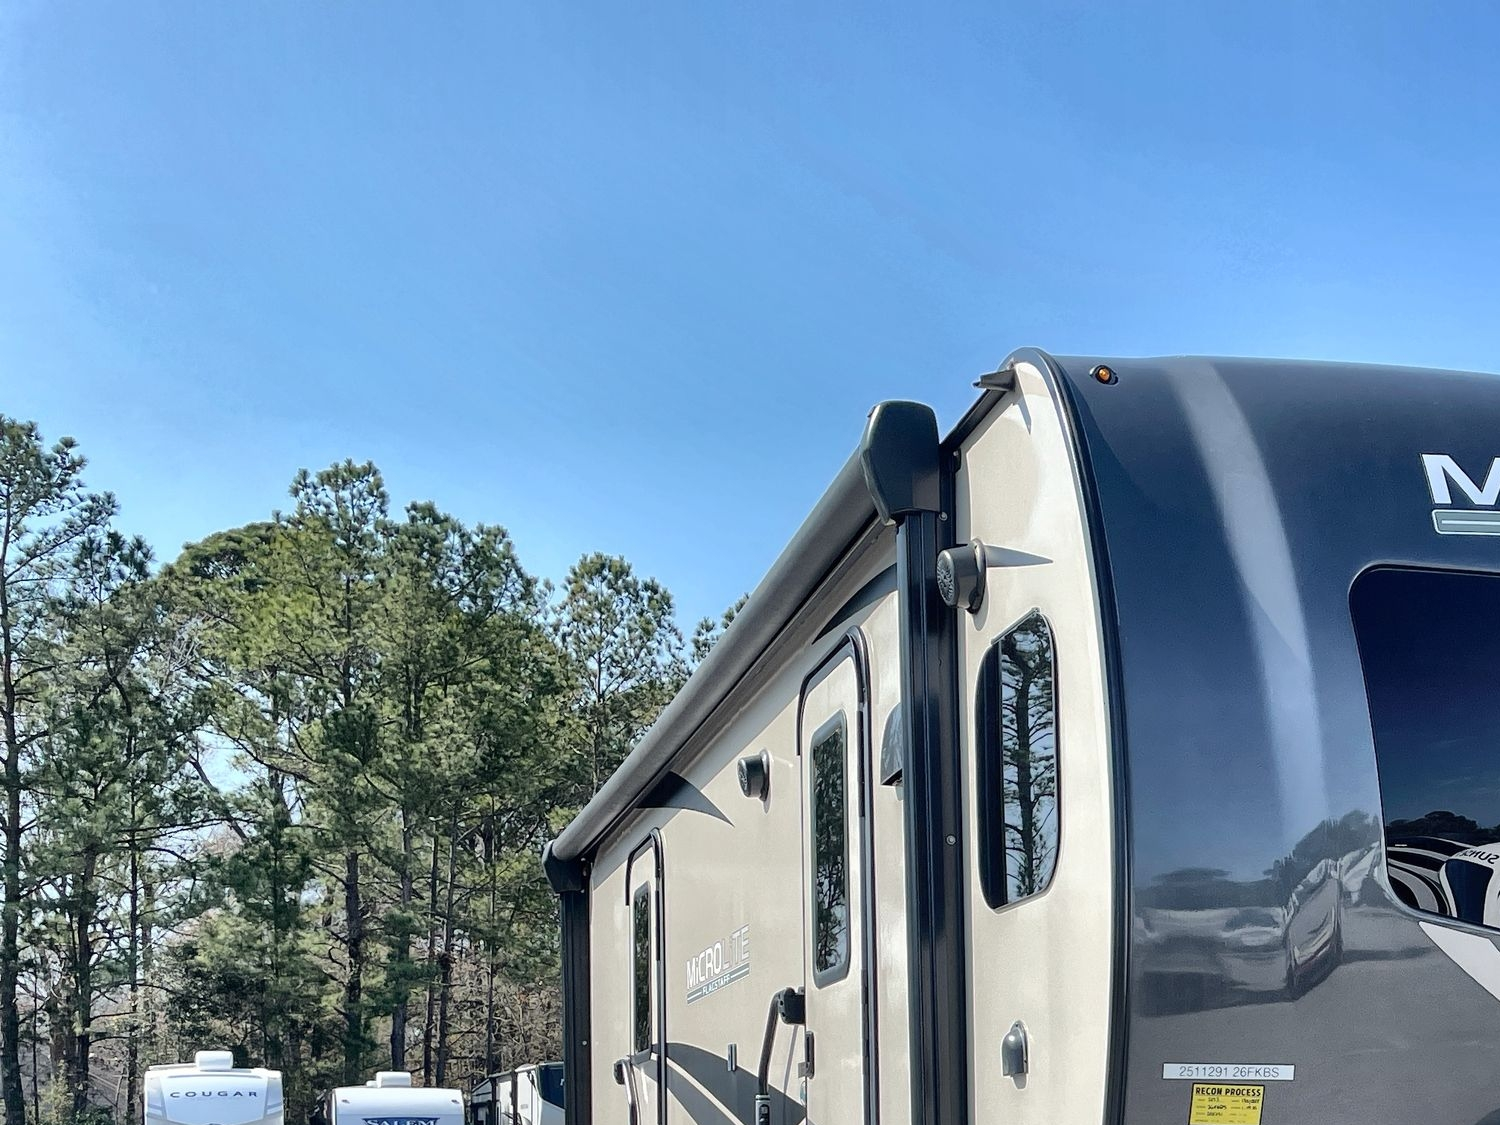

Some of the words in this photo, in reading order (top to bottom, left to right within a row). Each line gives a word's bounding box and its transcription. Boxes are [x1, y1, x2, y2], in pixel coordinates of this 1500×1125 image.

[1179, 1066, 1228, 1078] 2511291
[1232, 1066, 1280, 1078] 26FKBS
[1195, 1087, 1223, 1096] RECON
[1225, 1088, 1261, 1097] PROCESS
